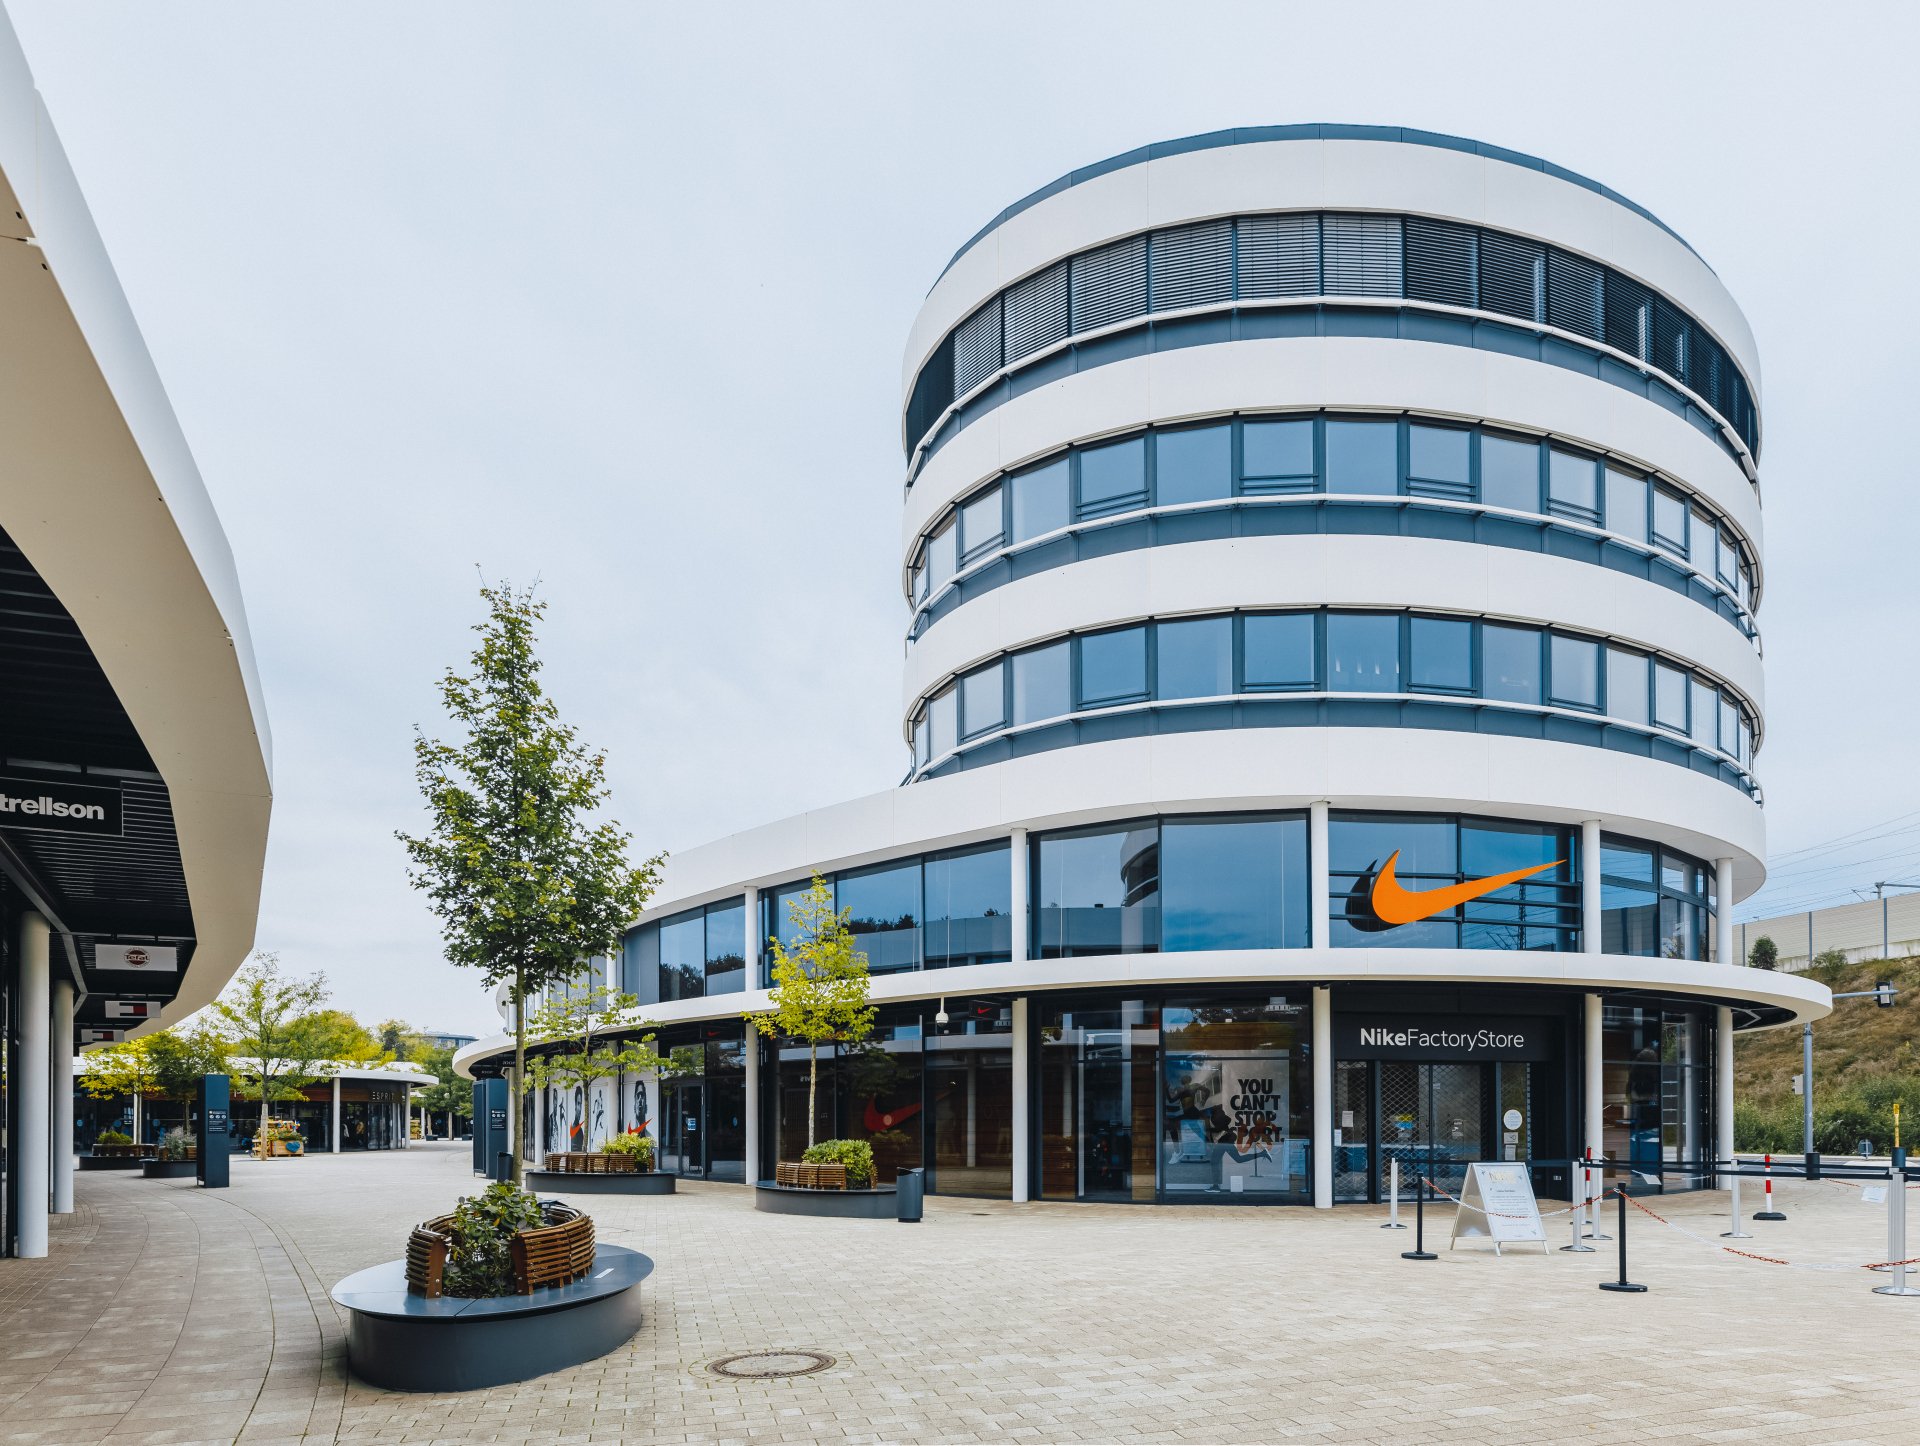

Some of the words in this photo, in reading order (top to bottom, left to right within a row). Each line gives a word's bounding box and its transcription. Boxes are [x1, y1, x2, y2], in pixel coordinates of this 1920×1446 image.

[0, 793, 105, 820] trellson
[1360, 1028, 1524, 1051] NikeFactoryStore
[1237, 1079, 1273, 1095] YOU
[372, 1091, 394, 1101] ESPRIT
[1230, 1094, 1281, 1111] CAN'T
[1235, 1110, 1277, 1126] STOP
